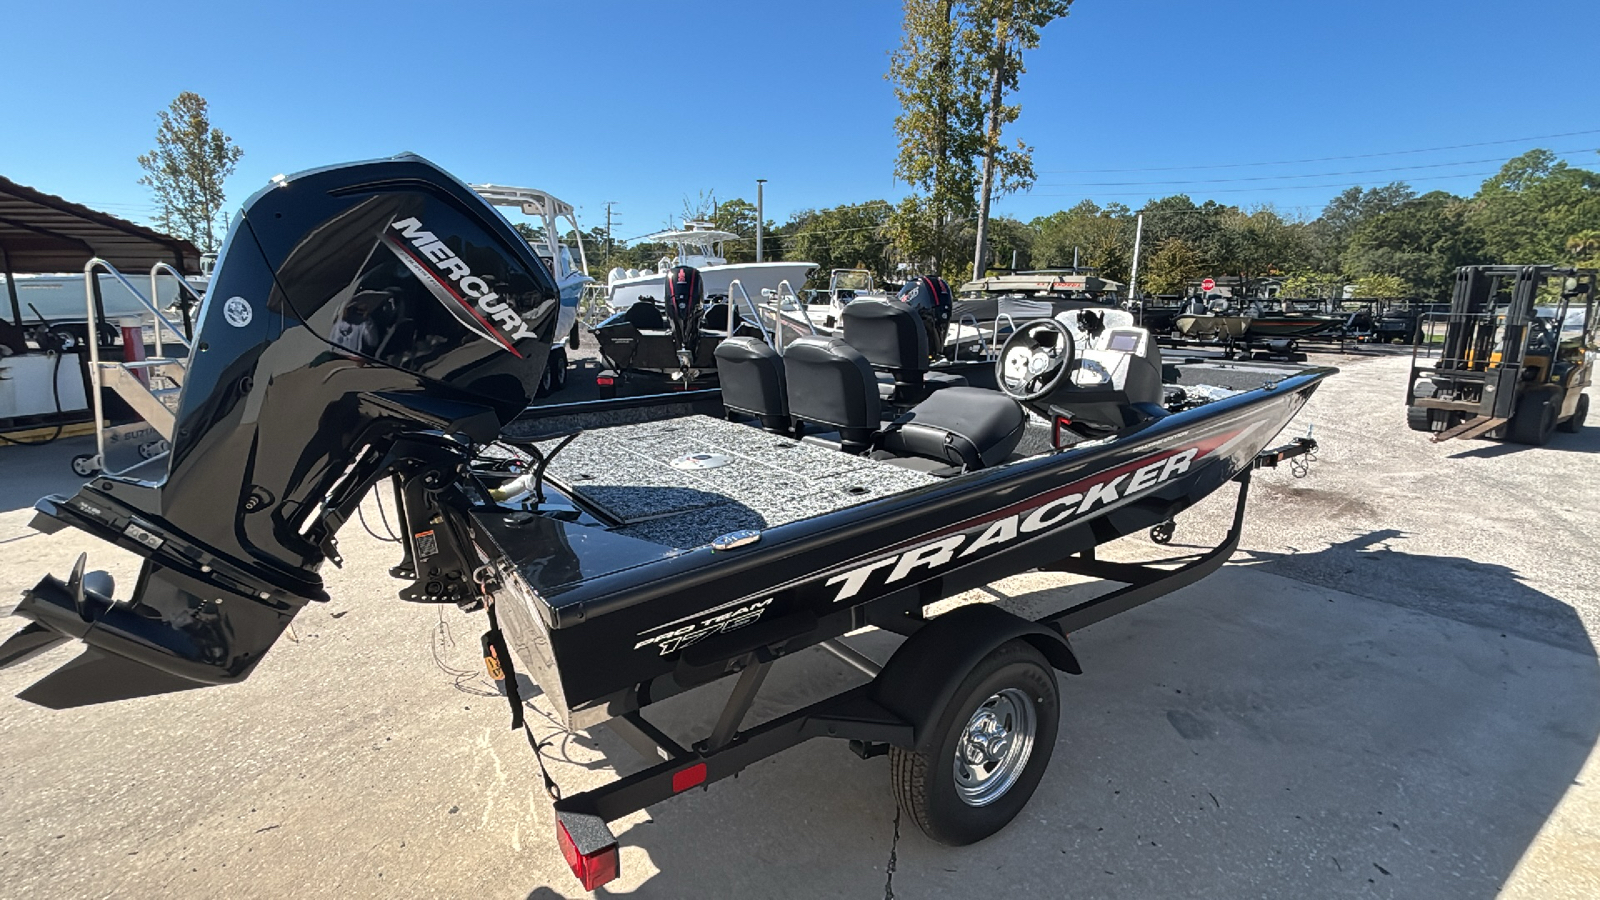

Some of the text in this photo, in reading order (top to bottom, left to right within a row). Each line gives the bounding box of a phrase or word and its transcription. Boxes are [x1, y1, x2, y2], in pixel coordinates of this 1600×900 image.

[392, 217, 535, 339] MERCURY
[824, 447, 1200, 603] TRACKER
[634, 597, 774, 650] PRO TEAM
